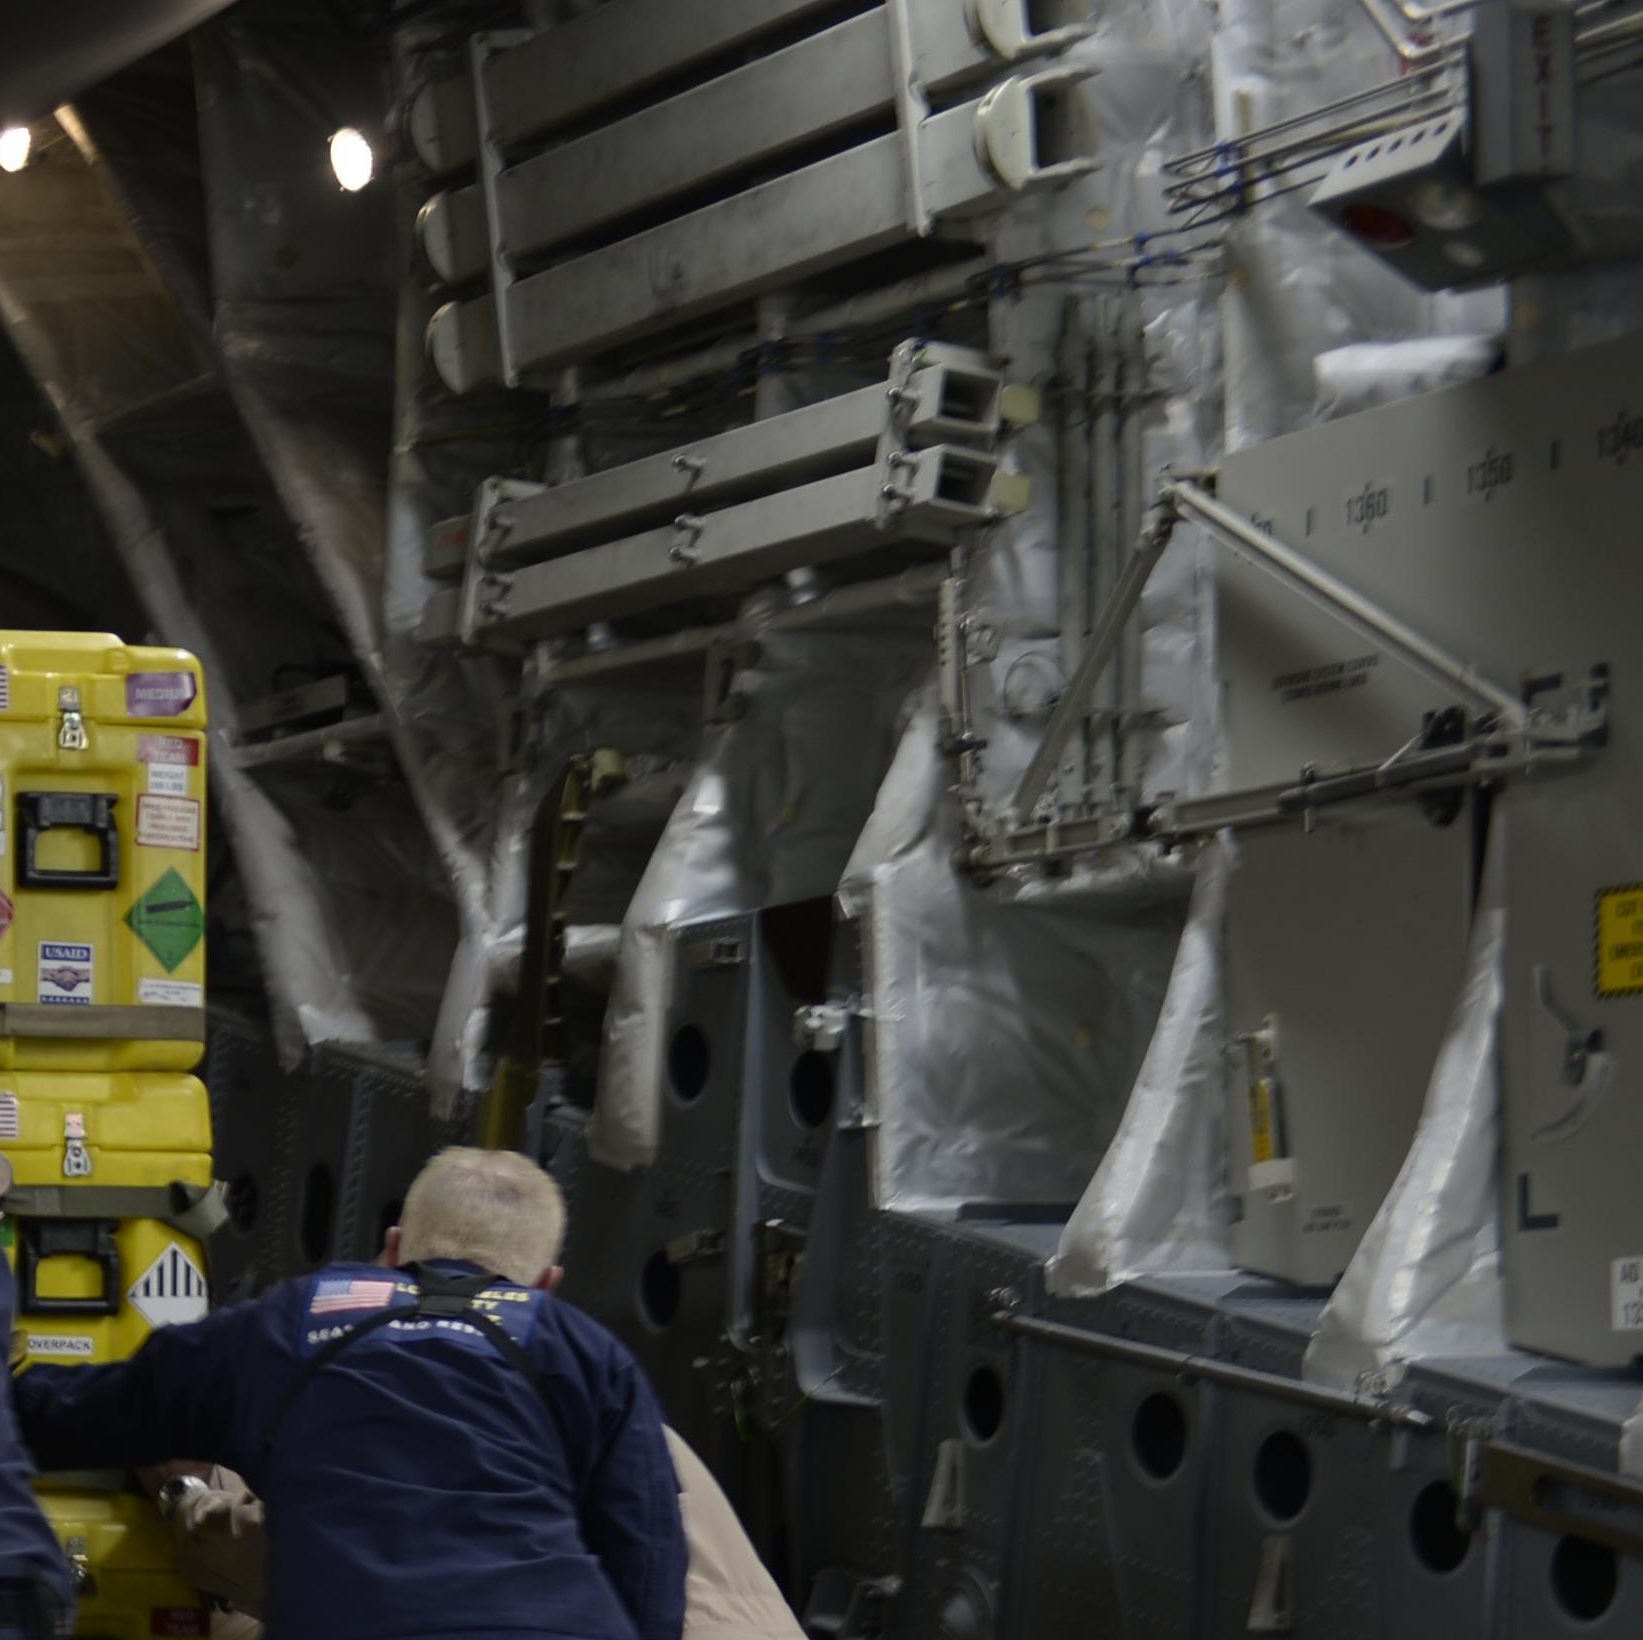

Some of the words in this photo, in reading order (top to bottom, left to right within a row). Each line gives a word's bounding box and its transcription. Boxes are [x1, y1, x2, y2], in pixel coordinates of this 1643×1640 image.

[1533, 15, 1552, 158] EXIT
[1347, 487, 1389, 526] 1360
[44, 945, 88, 959] USAID
[27, 1336, 92, 1351] OVERPACK
